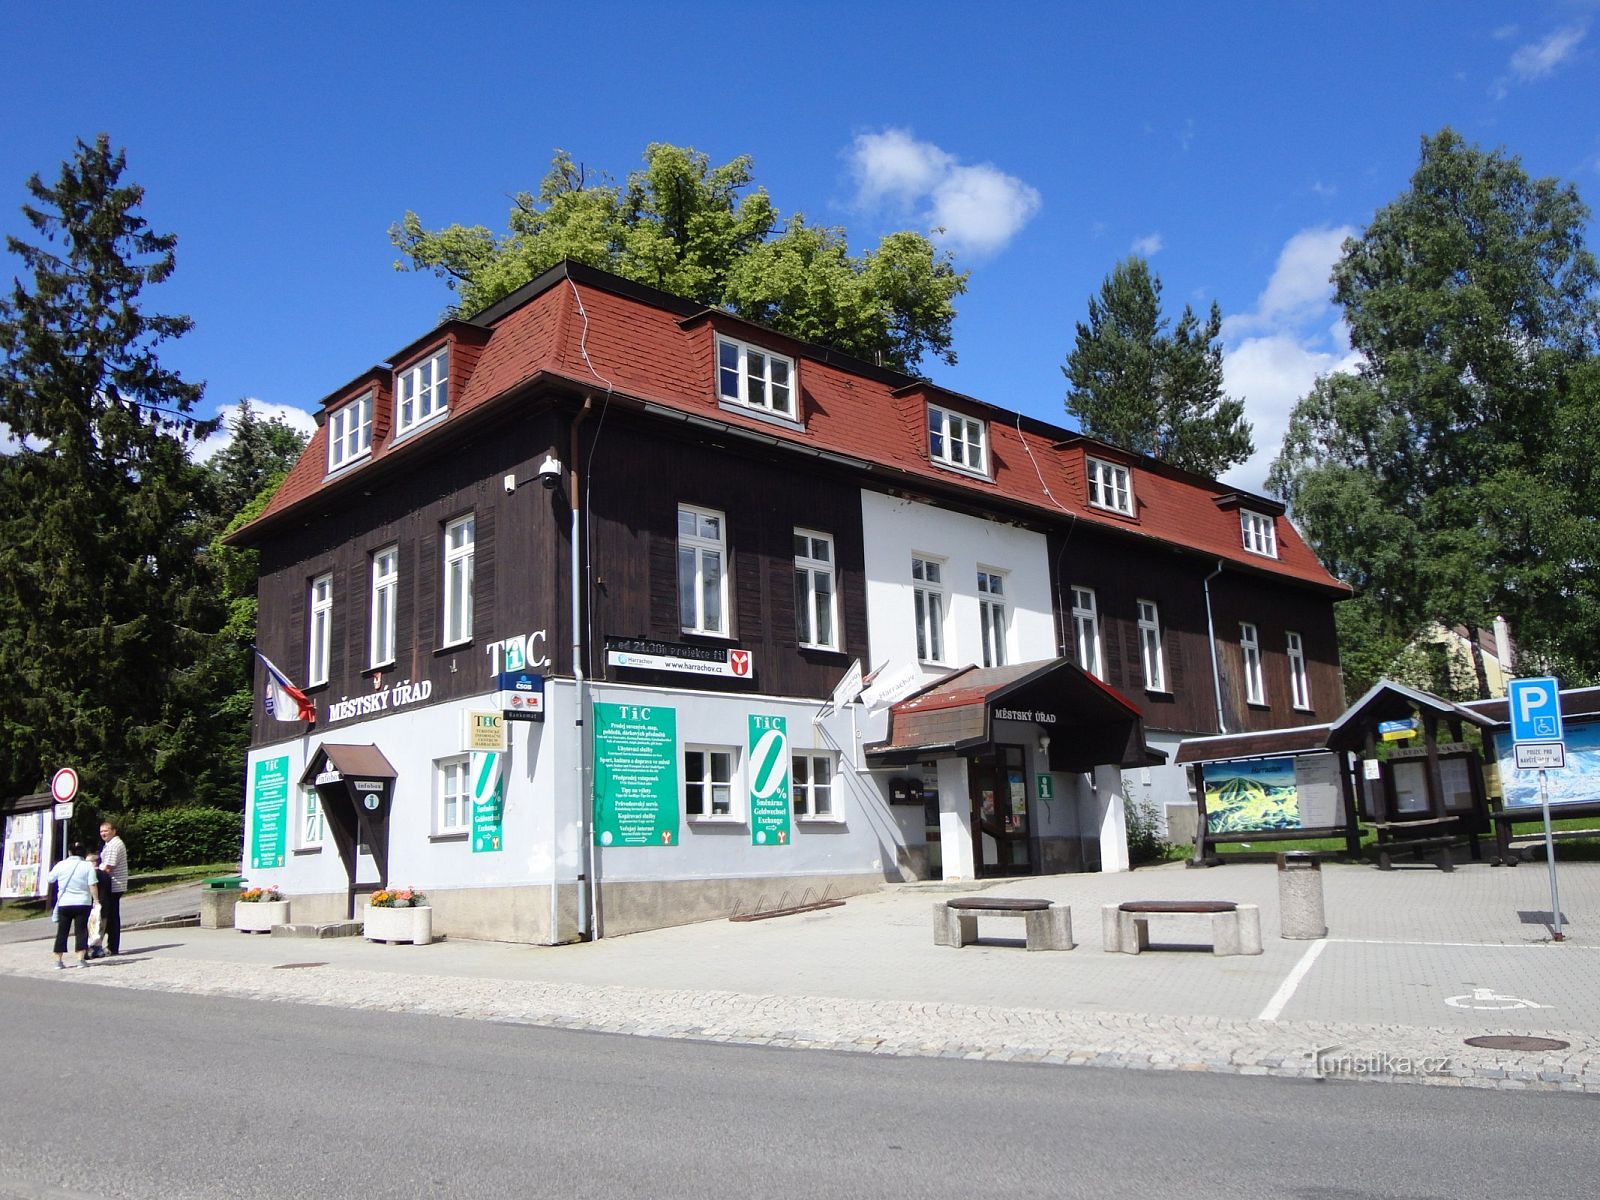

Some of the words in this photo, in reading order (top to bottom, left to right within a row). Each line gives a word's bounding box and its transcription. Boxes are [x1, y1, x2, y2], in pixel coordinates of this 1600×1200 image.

[665, 661, 722, 673] www.harrachov.cz
[329, 685, 389, 722] MĚSTSKÝ
[392, 680, 432, 706] ÚŘAD
[1519, 686, 1548, 722] P
[620, 705, 651, 720] TiC
[995, 707, 1032, 721] MĚSTSKÝ
[1035, 711, 1056, 723] ÚŘAD
[754, 717, 781, 729] TiC
